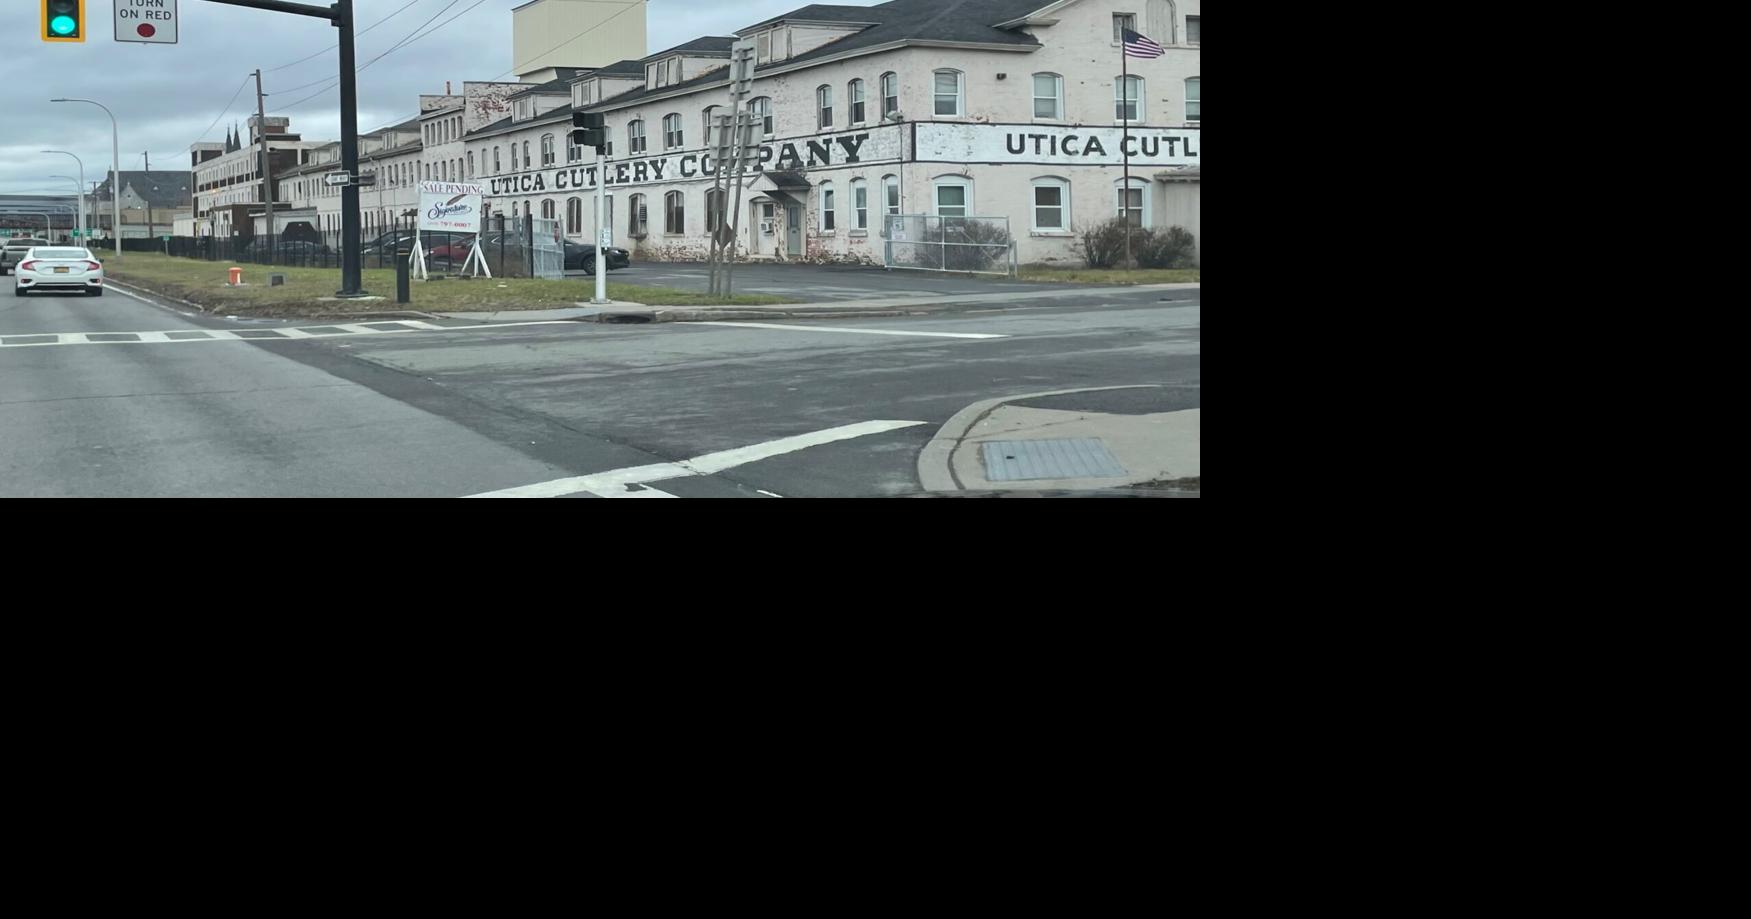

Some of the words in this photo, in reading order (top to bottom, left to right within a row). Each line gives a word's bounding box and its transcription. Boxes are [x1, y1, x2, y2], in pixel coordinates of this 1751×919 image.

[119, 9, 139, 19] ON
[145, 10, 172, 20] RED
[1006, 133, 1107, 156] UTICA
[490, 173, 546, 195] UTICA
[555, 158, 668, 189] CUTLERY
[680, 133, 870, 178] COPANY
[423, 183, 443, 193] SALE
[445, 183, 484, 194] PENDING
